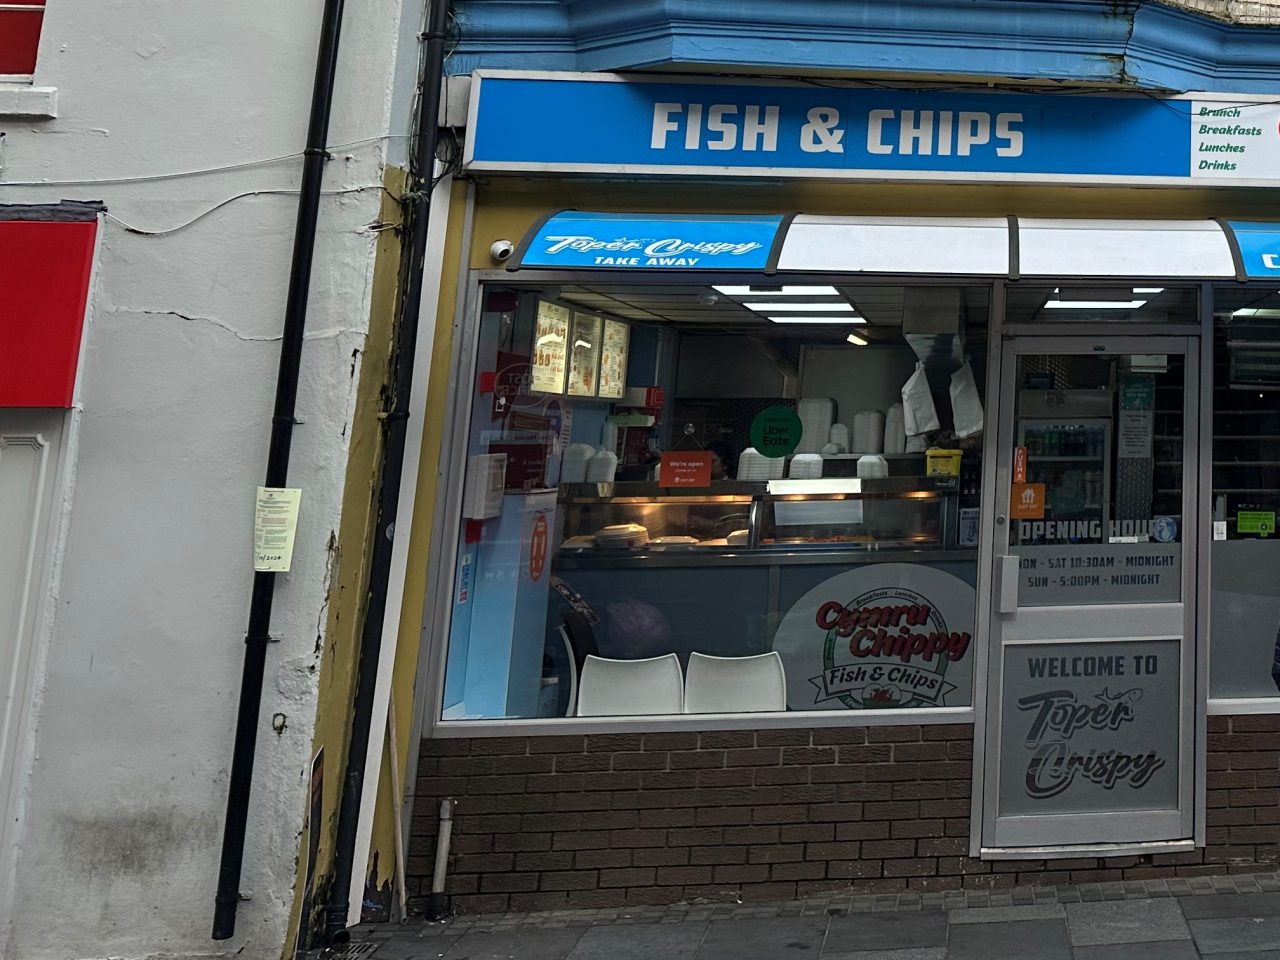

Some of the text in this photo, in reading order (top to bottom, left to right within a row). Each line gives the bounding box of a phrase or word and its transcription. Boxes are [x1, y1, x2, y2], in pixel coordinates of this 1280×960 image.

[1199, 106, 1241, 118] Brunch
[650, 102, 1024, 158] FISH & CHIPS
[1198, 125, 1262, 136] Breakfasts
[1198, 142, 1245, 153] Lunches
[1198, 159, 1237, 171] Drinks
[544, 235, 763, 258] Toper Crispy
[593, 256, 700, 266] TAKE AWAY
[763, 425, 790, 435] Uber
[762, 437, 789, 446] Eats
[1019, 520, 1102, 540] OPENING
[1048, 558, 1067, 569] SAT
[1070, 556, 1115, 568] 10:30AM
[1125, 555, 1174, 567] MIDNIGHT
[1028, 576, 1049, 588] SUN
[1060, 575, 1100, 587] 5:00PM
[1111, 574, 1161, 586] MIDNIGHT
[816, 601, 931, 638] Cymru
[849, 626, 972, 664] Chippy
[1027, 654, 1158, 679] WELCOME TO
[829, 666, 939, 690] Fish & Chips
[1016, 689, 1134, 749] Toper
[1025, 740, 1166, 800] Crispy
